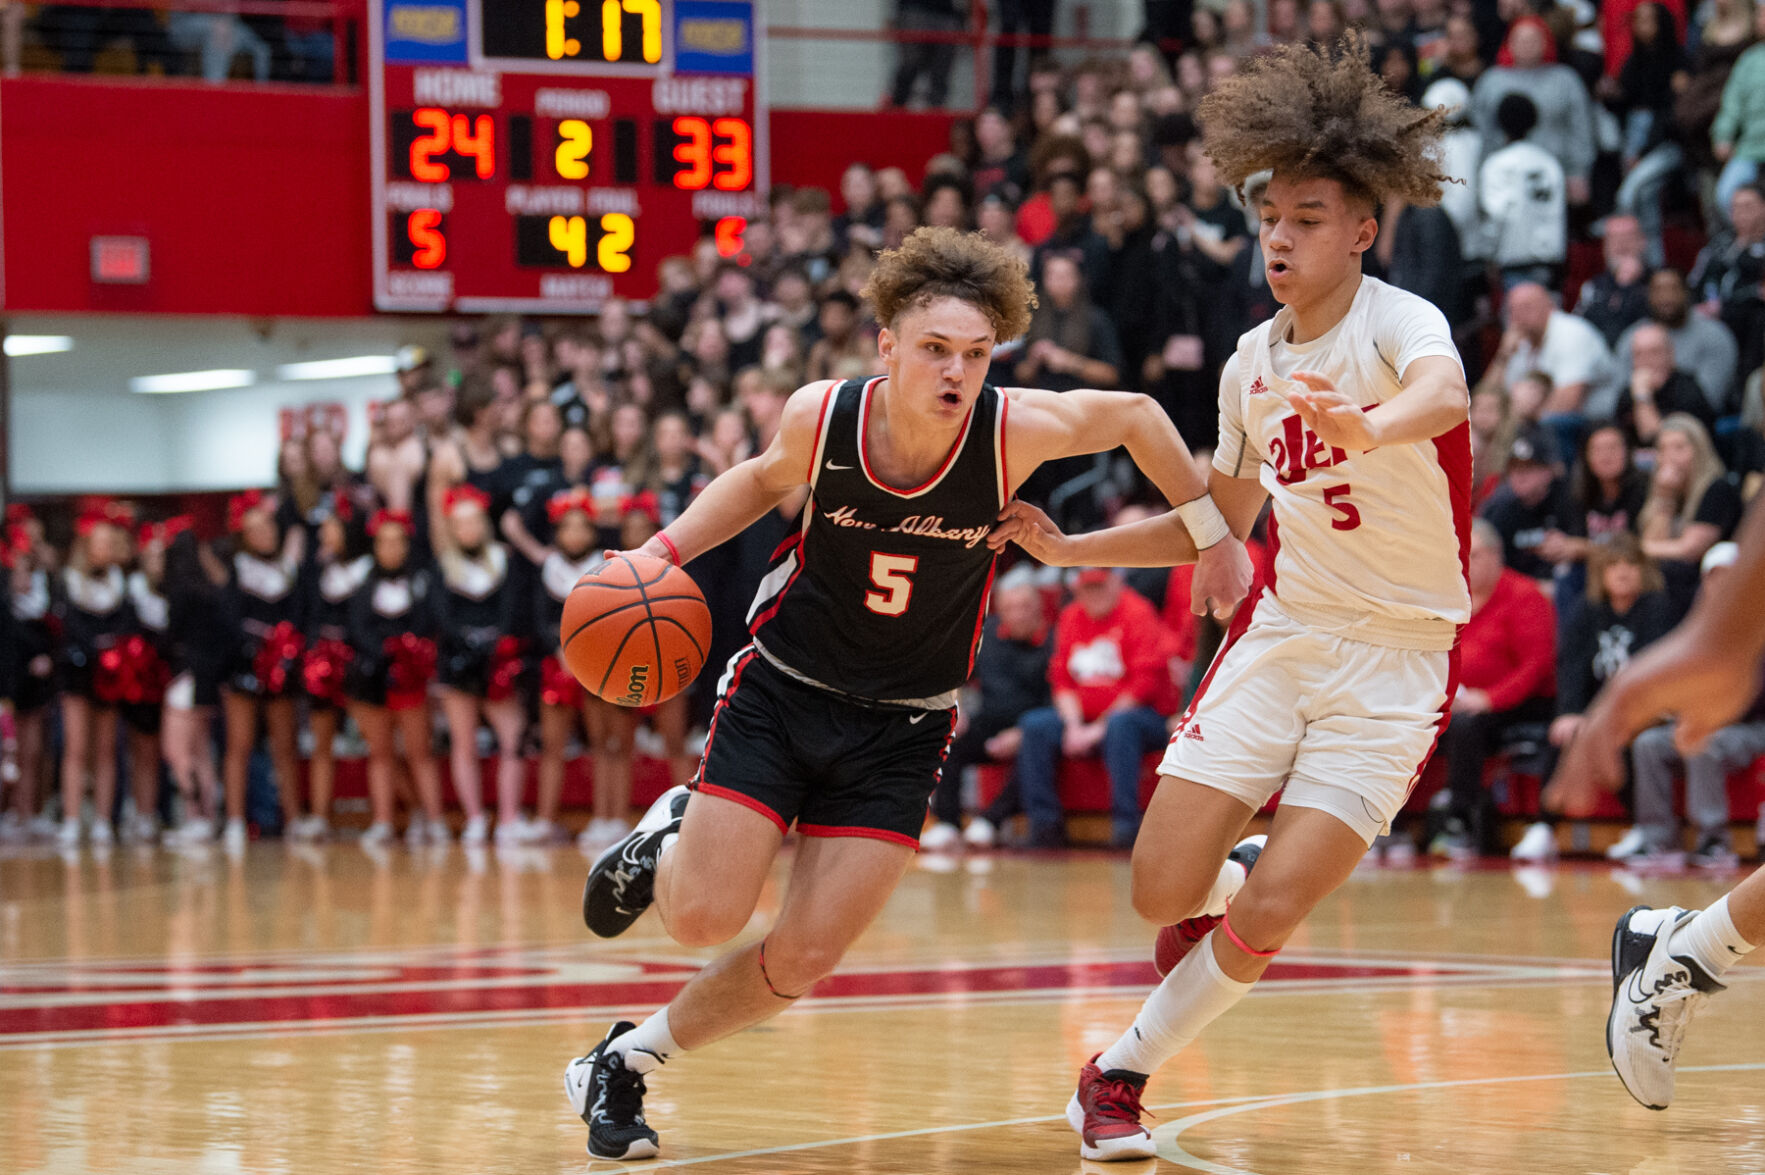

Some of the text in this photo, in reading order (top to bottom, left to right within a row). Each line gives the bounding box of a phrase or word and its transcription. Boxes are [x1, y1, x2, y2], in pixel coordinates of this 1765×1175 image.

[545, 0, 662, 64] 1:17
[414, 68, 499, 106] HOME
[652, 78, 747, 114] GUEST
[409, 108, 495, 183] 24
[555, 119, 593, 180] 2
[672, 116, 753, 191] 33
[407, 208, 447, 269] 5
[881, 515, 991, 549] Albany
[1323, 484, 1362, 532] 5
[864, 550, 919, 618] 5
